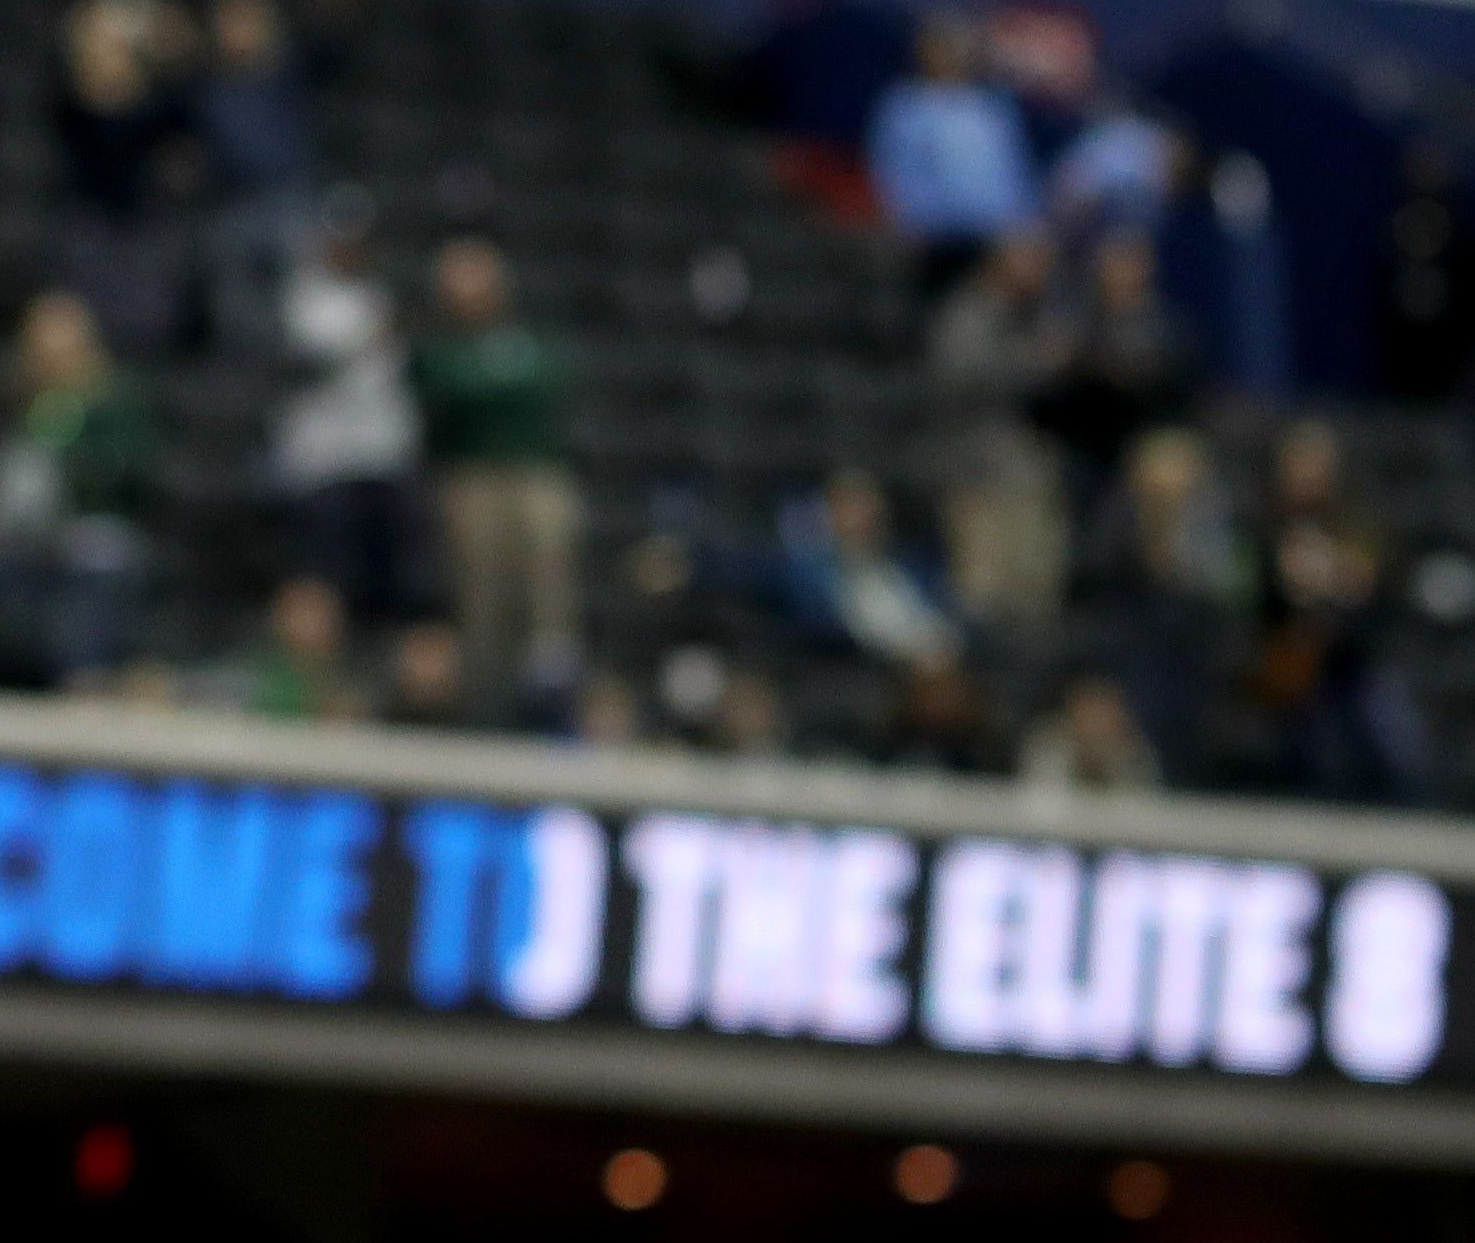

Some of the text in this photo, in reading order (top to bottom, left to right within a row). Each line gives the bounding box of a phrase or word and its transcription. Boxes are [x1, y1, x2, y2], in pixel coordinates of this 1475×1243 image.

[403, 798, 606, 1022] TO
[623, 808, 918, 1046] THE
[923, 834, 1323, 1078] ELITE
[1323, 866, 1451, 1085] 8
